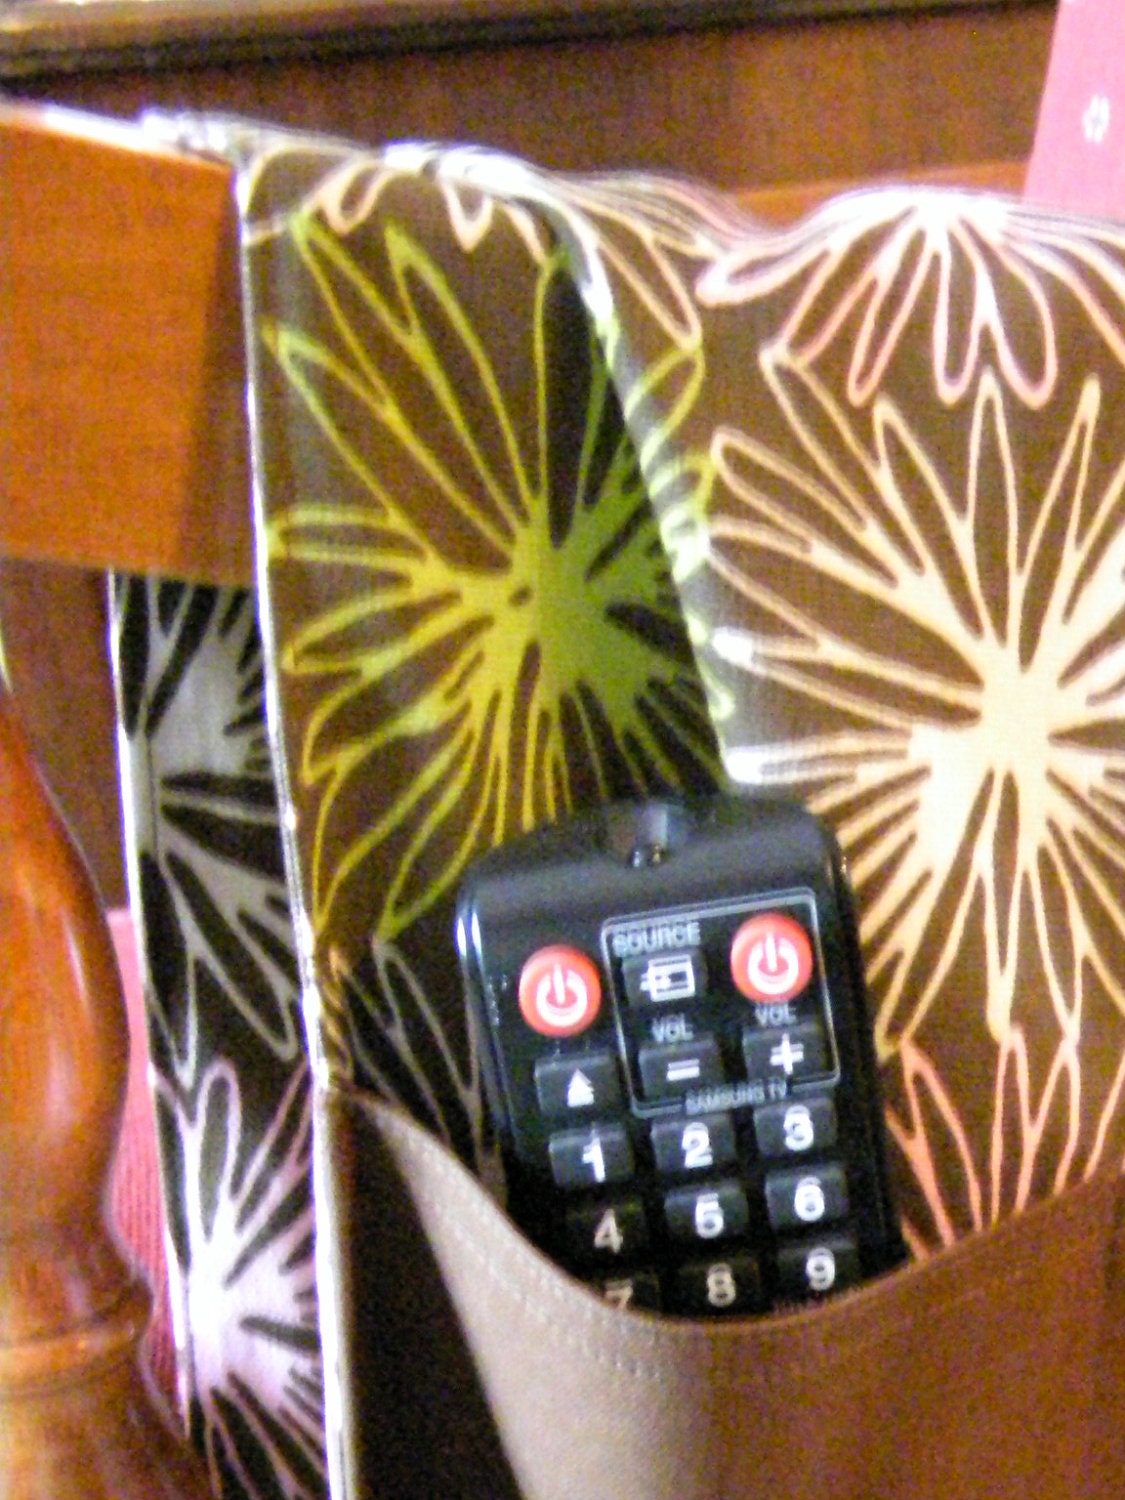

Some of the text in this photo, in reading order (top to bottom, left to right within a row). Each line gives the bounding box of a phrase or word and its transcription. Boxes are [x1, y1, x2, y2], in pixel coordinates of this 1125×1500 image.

[612, 921, 700, 958] SOURCE
[652, 1014, 694, 1043] VOL
[755, 1002, 797, 1027] VOL
[685, 1077, 788, 1115] SAMSUNG TV
[682, 1122, 714, 1169] 2
[784, 1104, 815, 1152] 3
[582, 1126, 606, 1184] 1
[695, 1192, 725, 1239] 5
[794, 1177, 825, 1222] 6
[594, 1208, 624, 1254] 4
[707, 1262, 737, 1307] 8
[806, 1247, 836, 1291] 9
